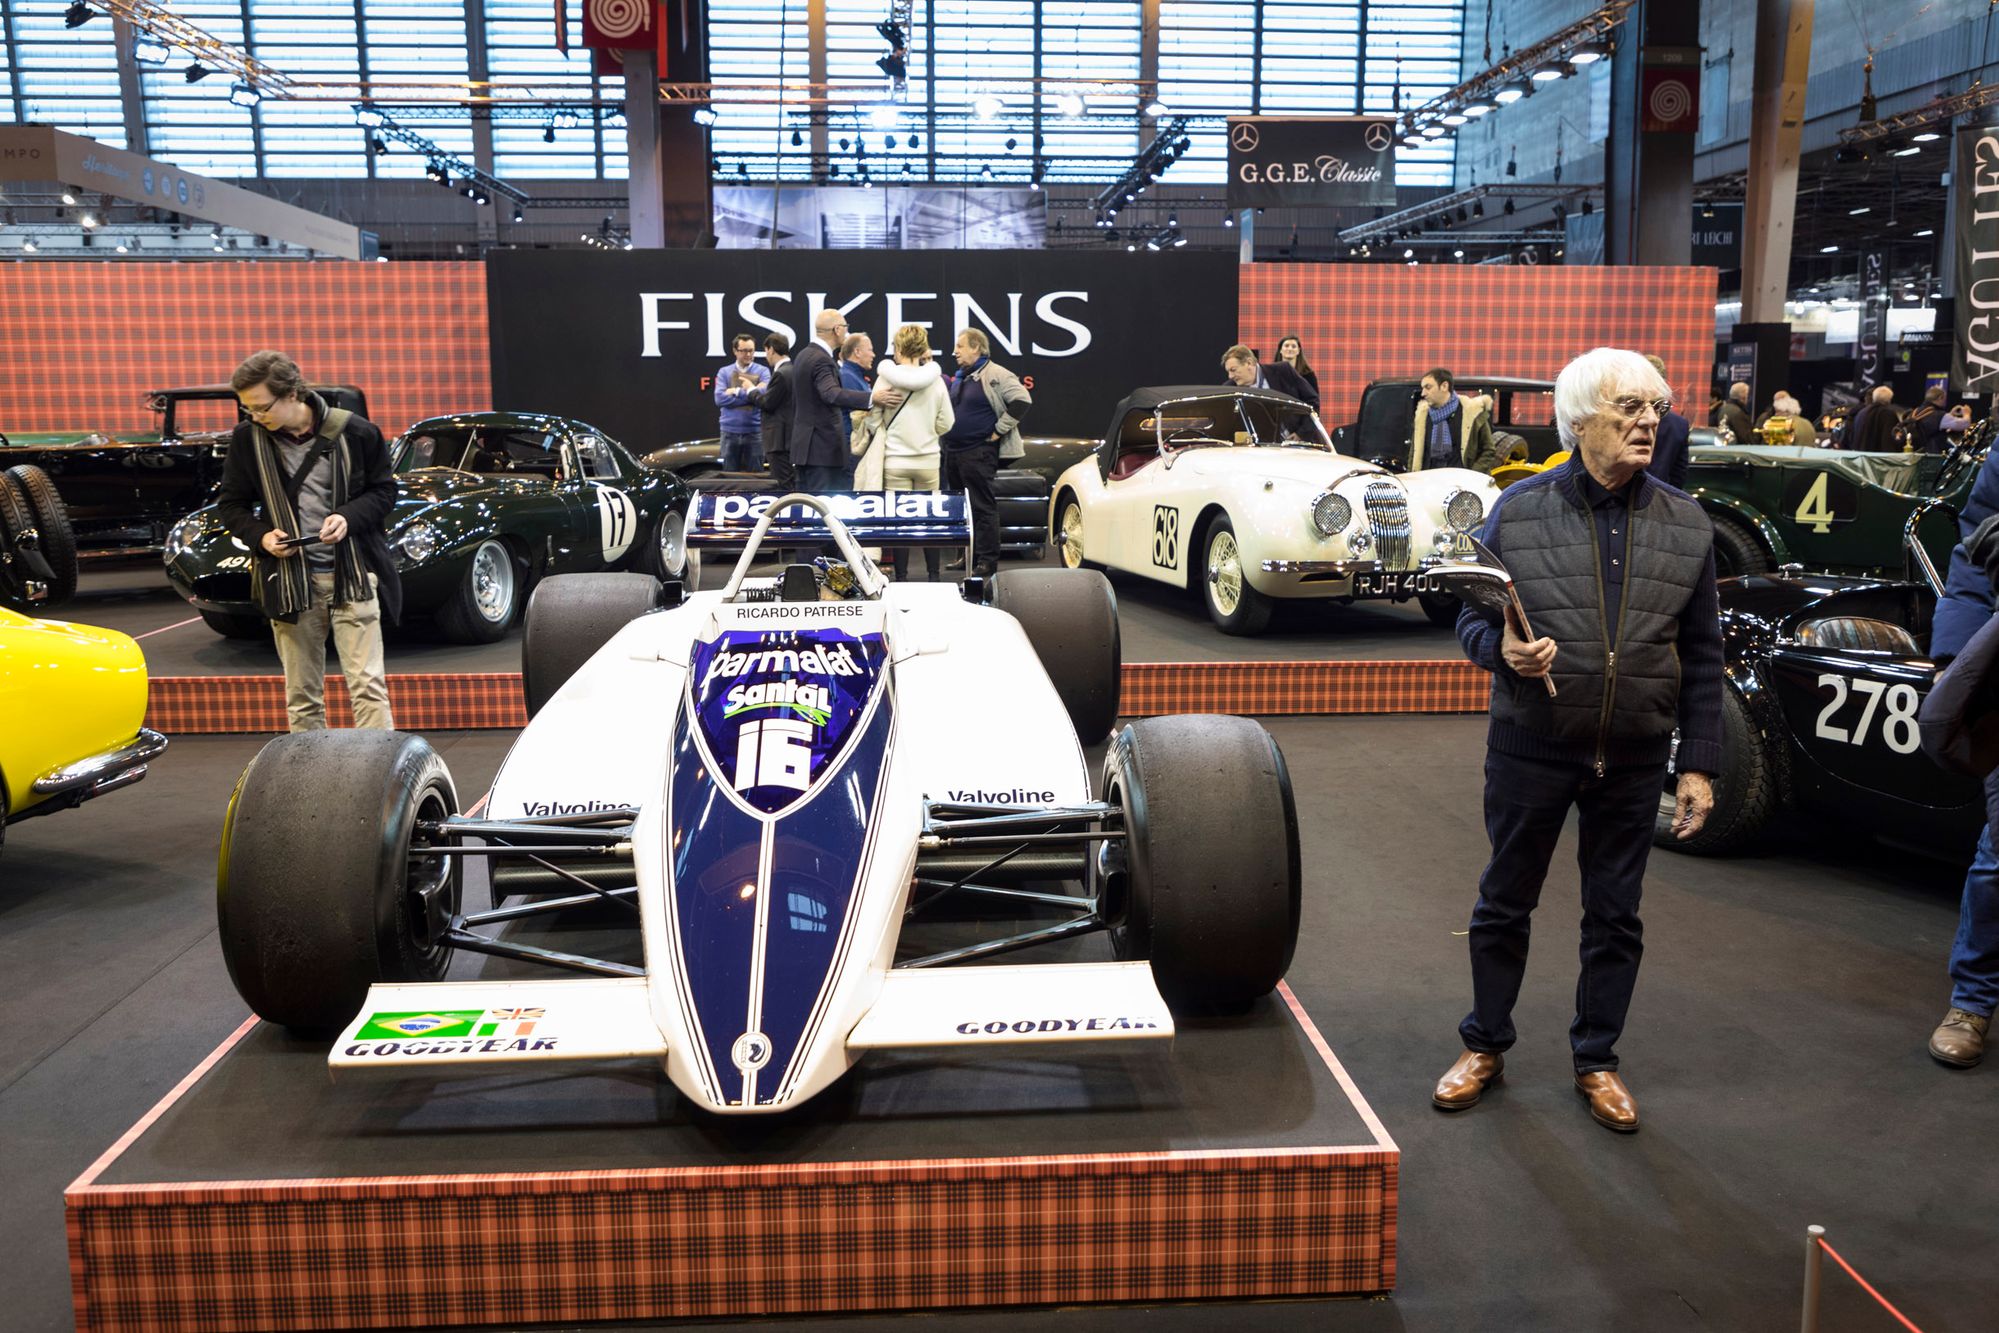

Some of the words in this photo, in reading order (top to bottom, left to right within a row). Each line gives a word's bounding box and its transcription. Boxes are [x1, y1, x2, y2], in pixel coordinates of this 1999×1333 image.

[1240, 162, 1316, 184] G.G.E.
[1314, 154, 1382, 184] Classic
[639, 290, 1093, 359] FISKENS
[602, 491, 626, 548] 17
[714, 490, 950, 532] parmalat
[1795, 471, 1835, 533] 4
[1359, 574, 1399, 595] RJH
[737, 606, 800, 619] RICARDO
[804, 605, 864, 618] PATRESE
[700, 643, 864, 690] parmalat
[1816, 673, 1921, 754] 278
[734, 718, 813, 792] 16
[948, 788, 1055, 804] Valvoline
[344, 1036, 559, 1056] GOODYEAR
[956, 1016, 1157, 1035] GOODYEAR
